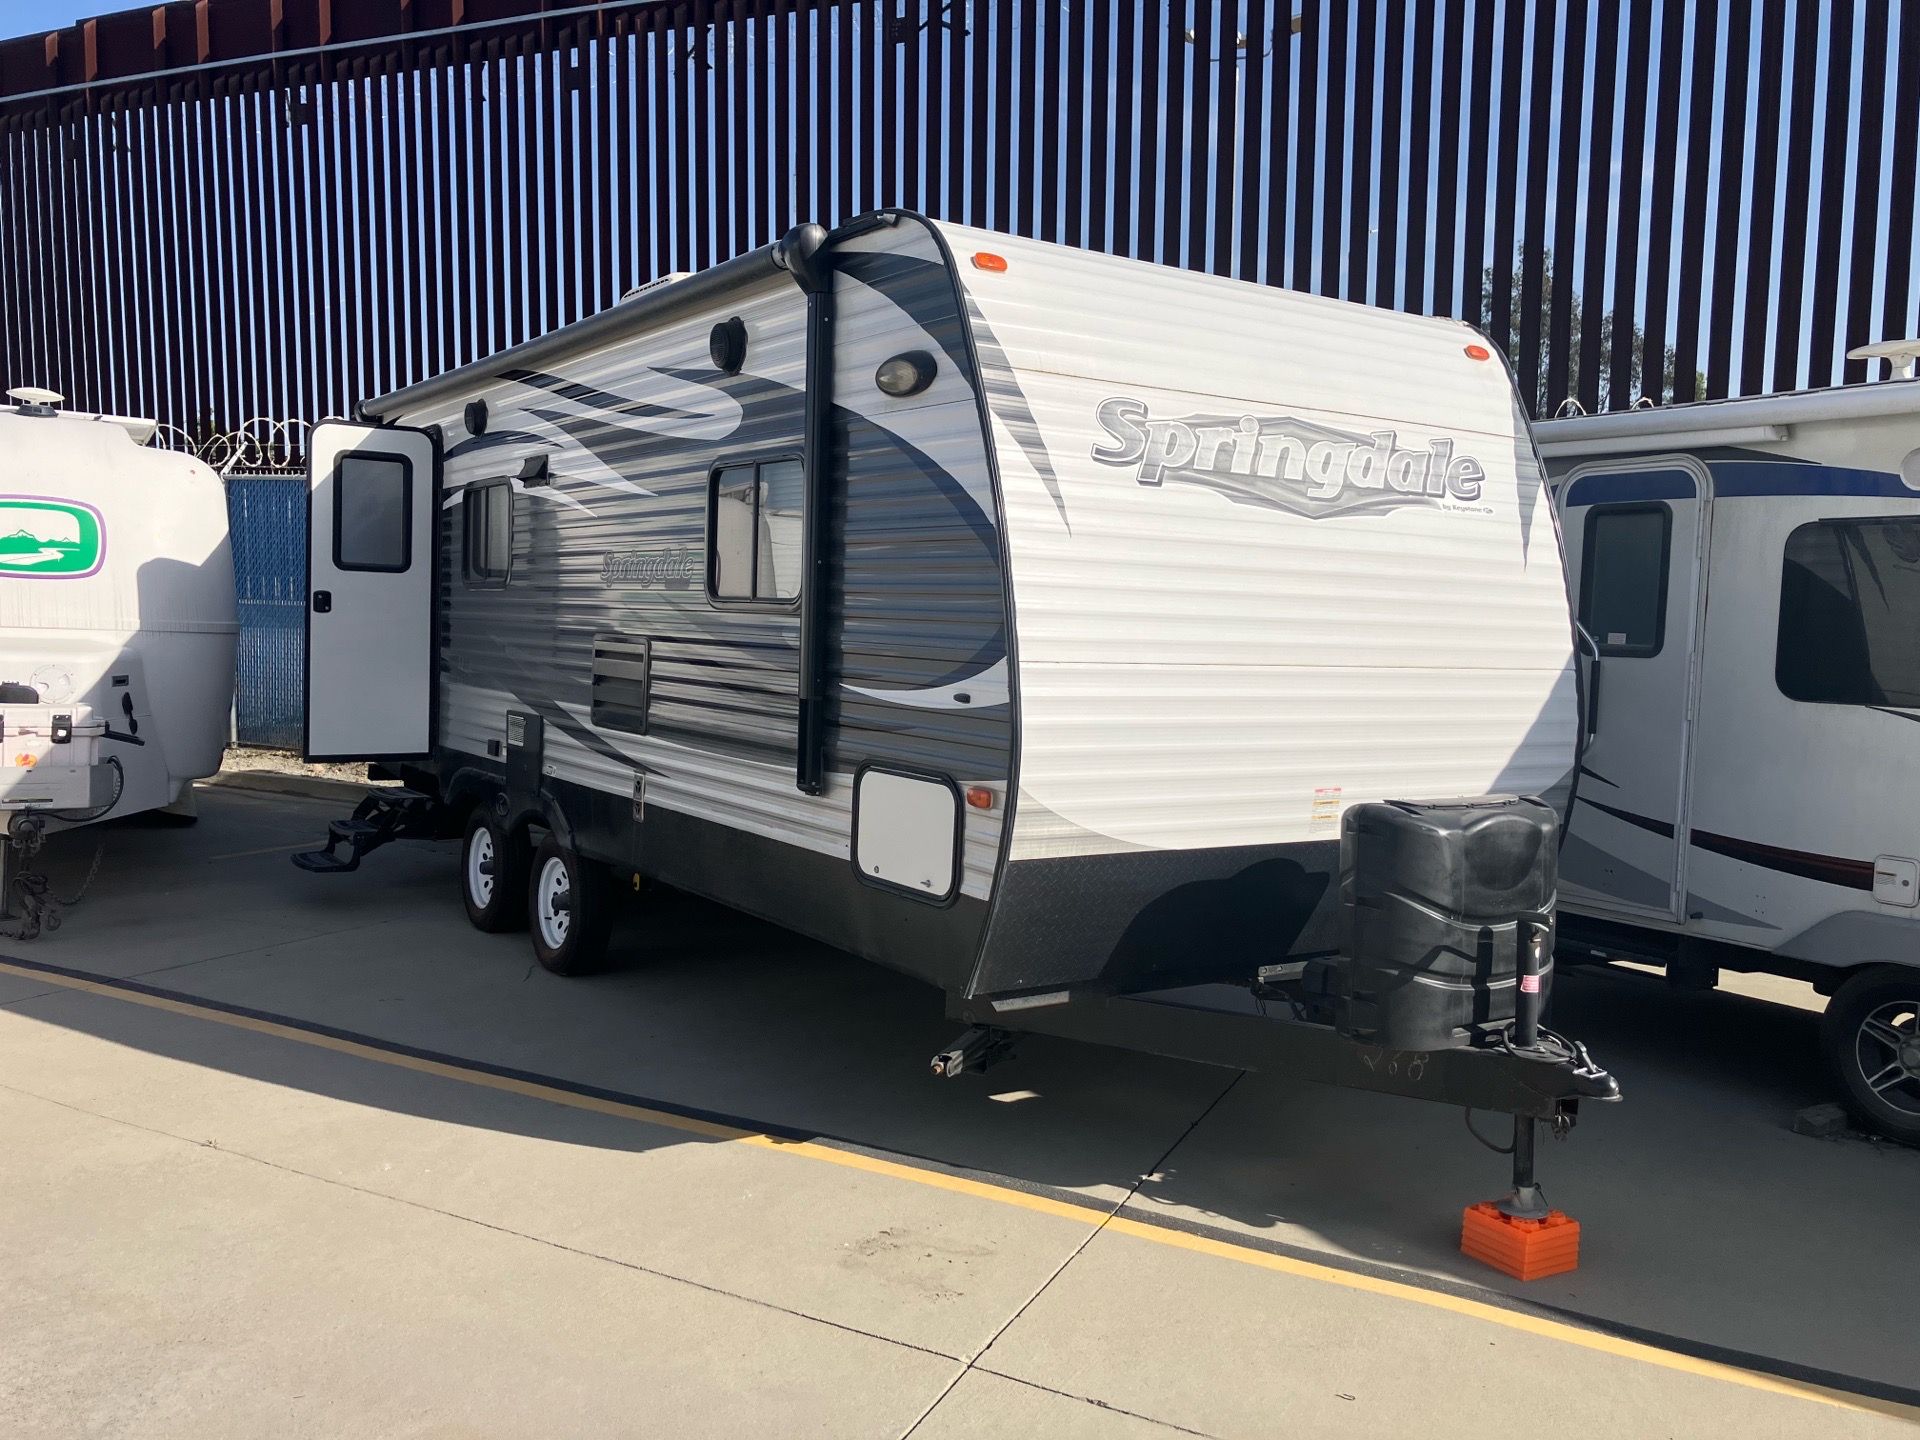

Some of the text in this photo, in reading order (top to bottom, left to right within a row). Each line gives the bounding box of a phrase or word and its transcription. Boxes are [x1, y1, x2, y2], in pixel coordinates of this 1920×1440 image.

[1091, 397, 1485, 501] Springdale
[1452, 504, 1483, 513] Keystone
[600, 547, 694, 588] Springdale
